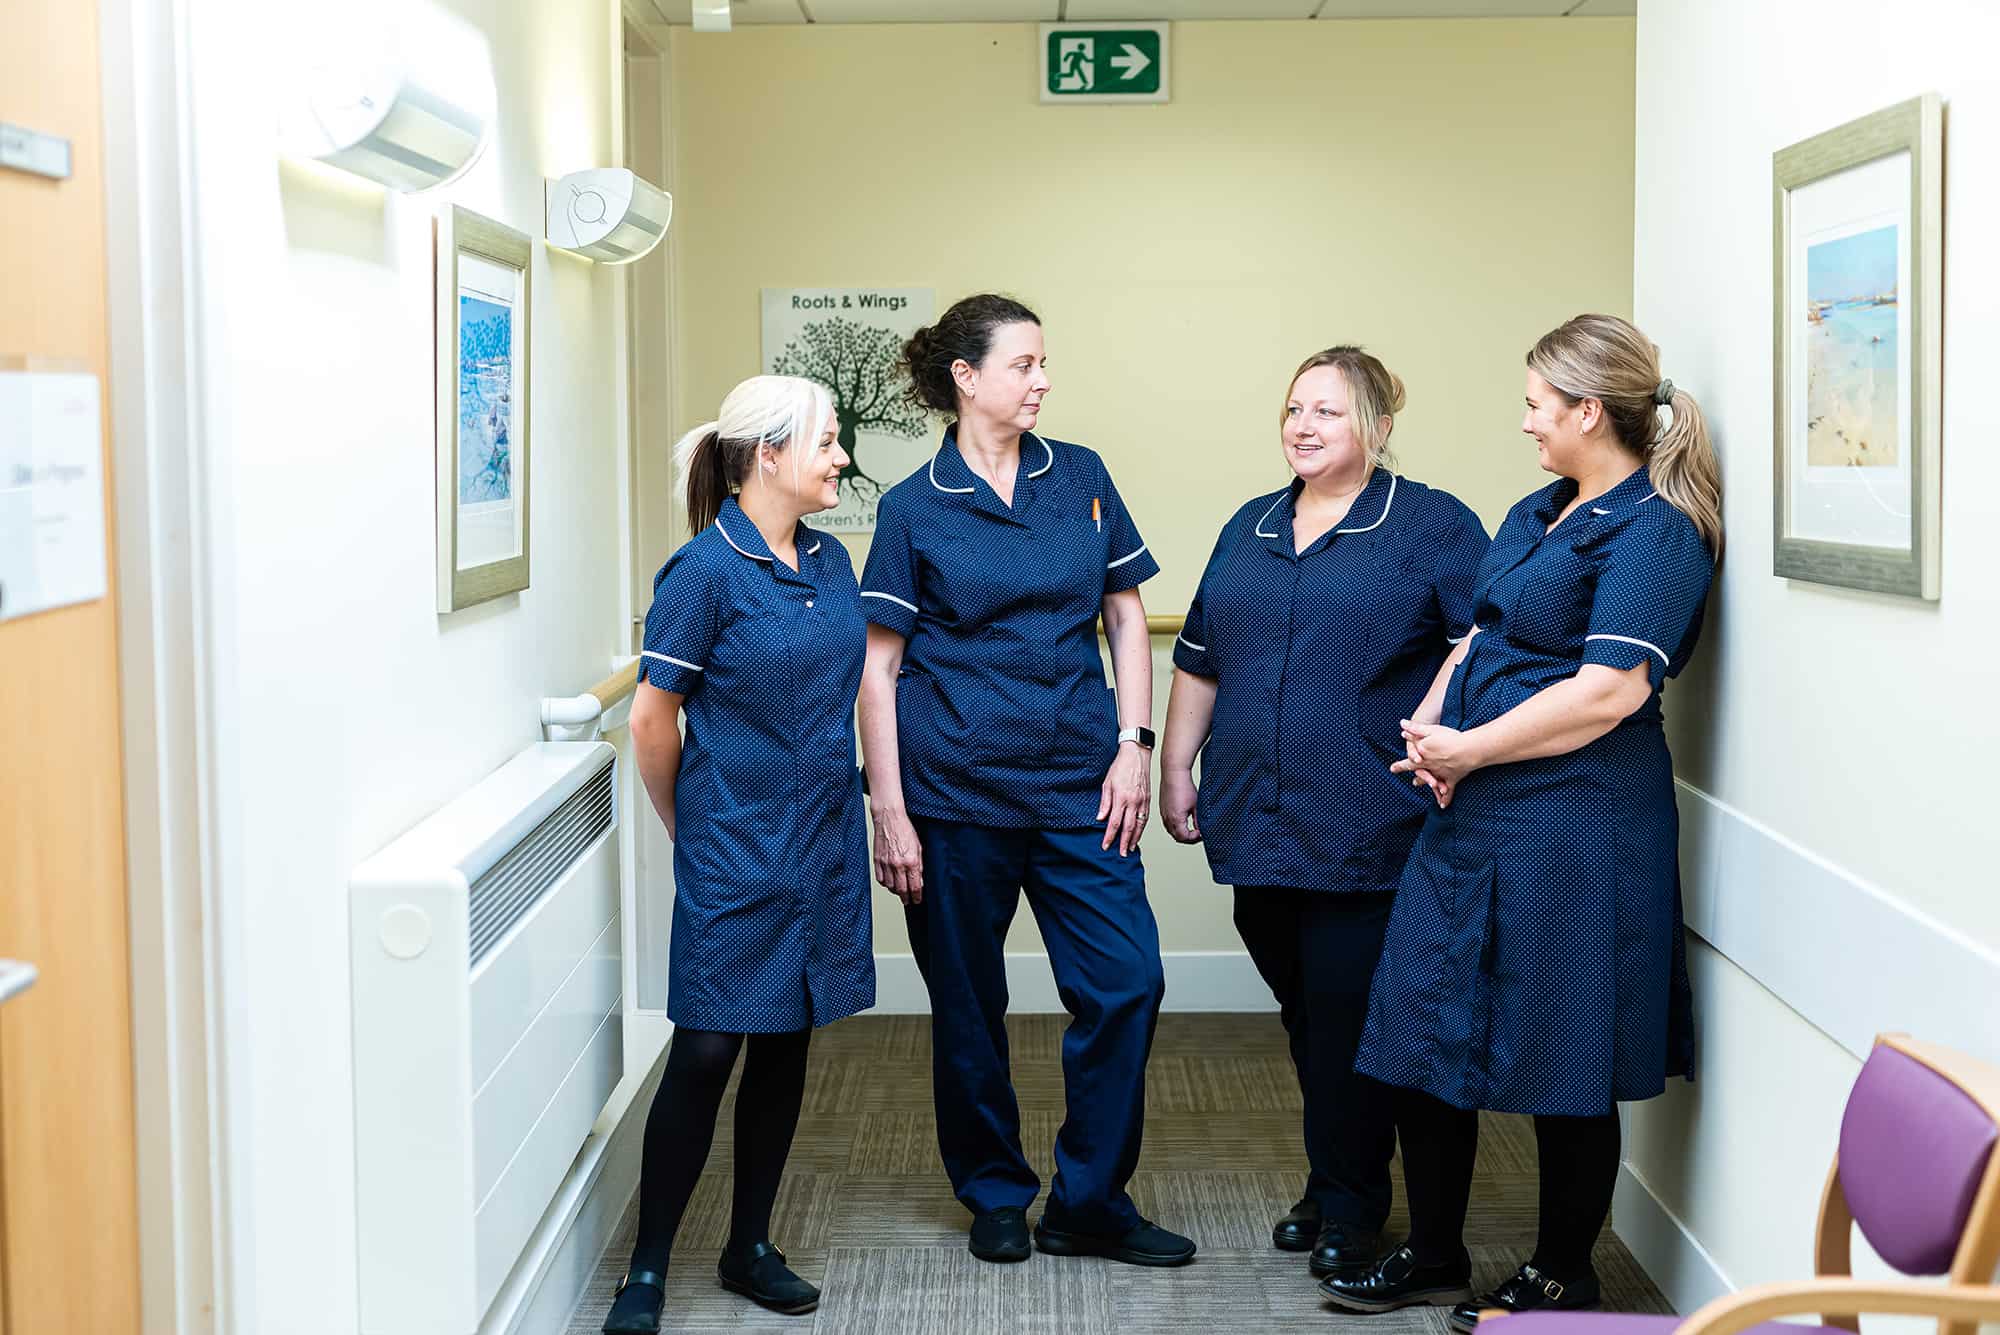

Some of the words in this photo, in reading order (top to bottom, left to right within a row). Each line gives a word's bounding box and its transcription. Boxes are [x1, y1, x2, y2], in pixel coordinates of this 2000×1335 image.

[792, 295, 836, 309] Roots
[842, 295, 852, 308] &
[858, 293, 907, 311] Wings
[804, 513, 865, 527] hildren's
